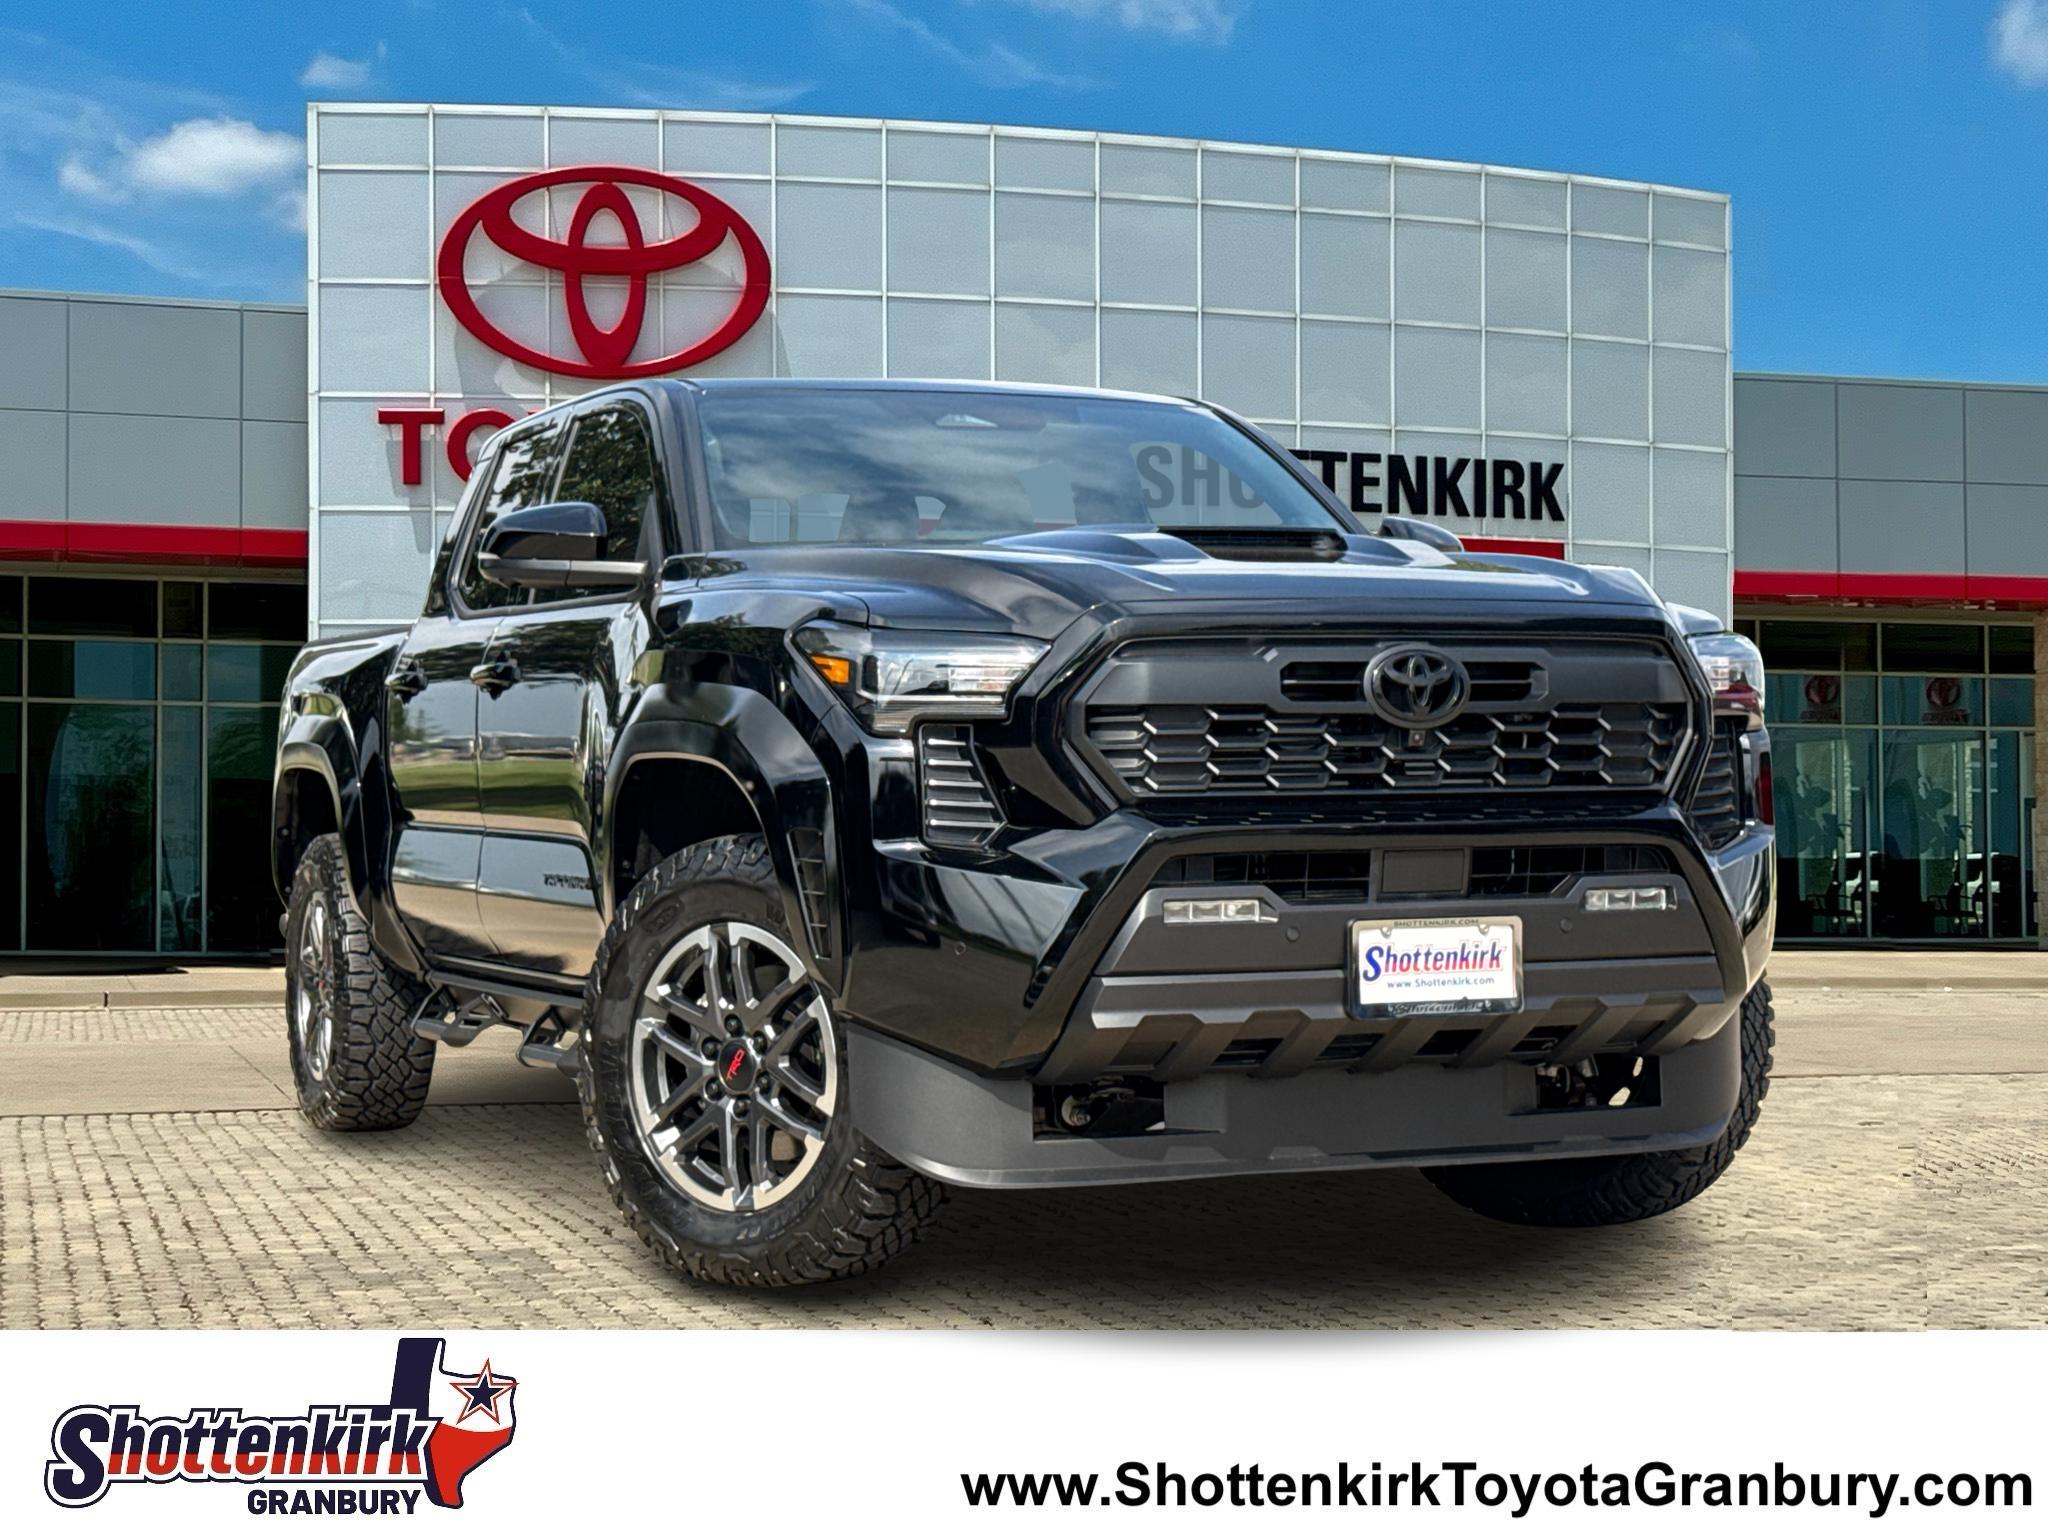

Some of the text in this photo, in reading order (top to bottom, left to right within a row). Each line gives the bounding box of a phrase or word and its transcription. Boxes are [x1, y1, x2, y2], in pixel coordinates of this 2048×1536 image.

[1362, 941, 1503, 982] Shottenkirk
[1387, 976, 1495, 989] www.Shottenkirk.com
[726, 1048, 746, 1081] TRD
